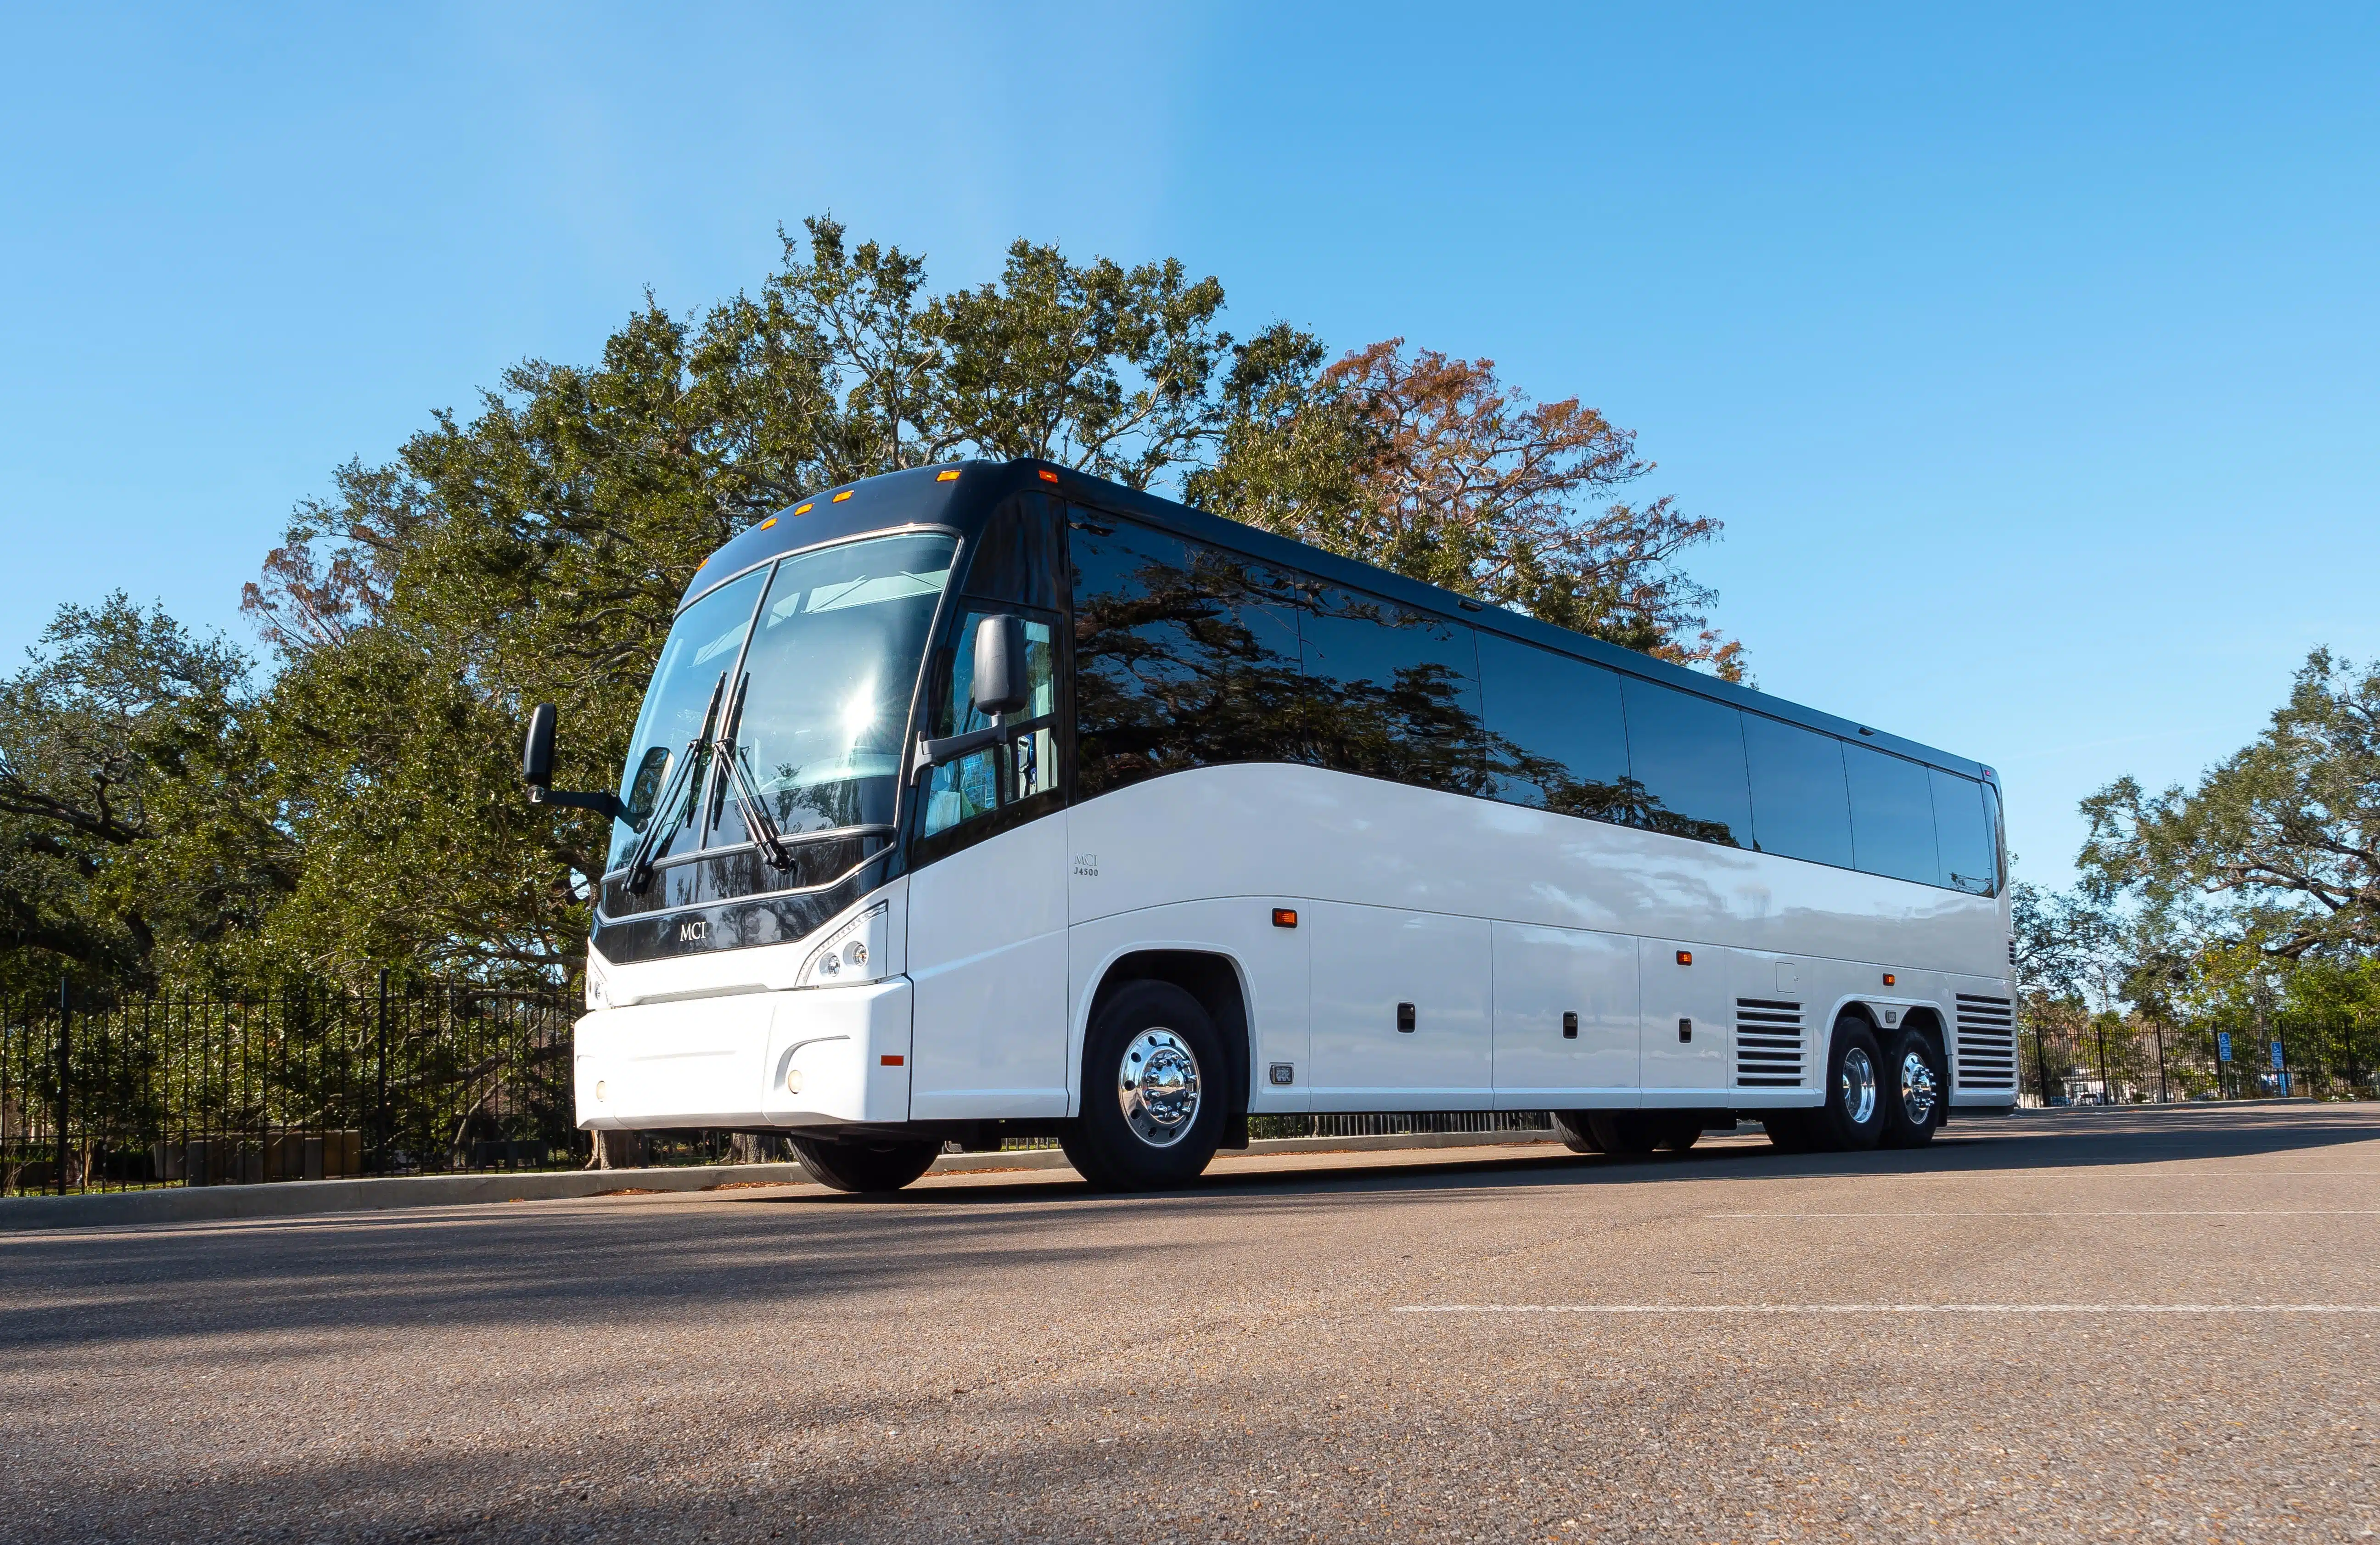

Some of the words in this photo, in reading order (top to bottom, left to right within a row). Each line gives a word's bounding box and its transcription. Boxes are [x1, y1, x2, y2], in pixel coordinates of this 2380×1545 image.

[1074, 853, 1098, 866] MCI
[1073, 867, 1099, 876] J4500
[679, 921, 707, 942] MCI
